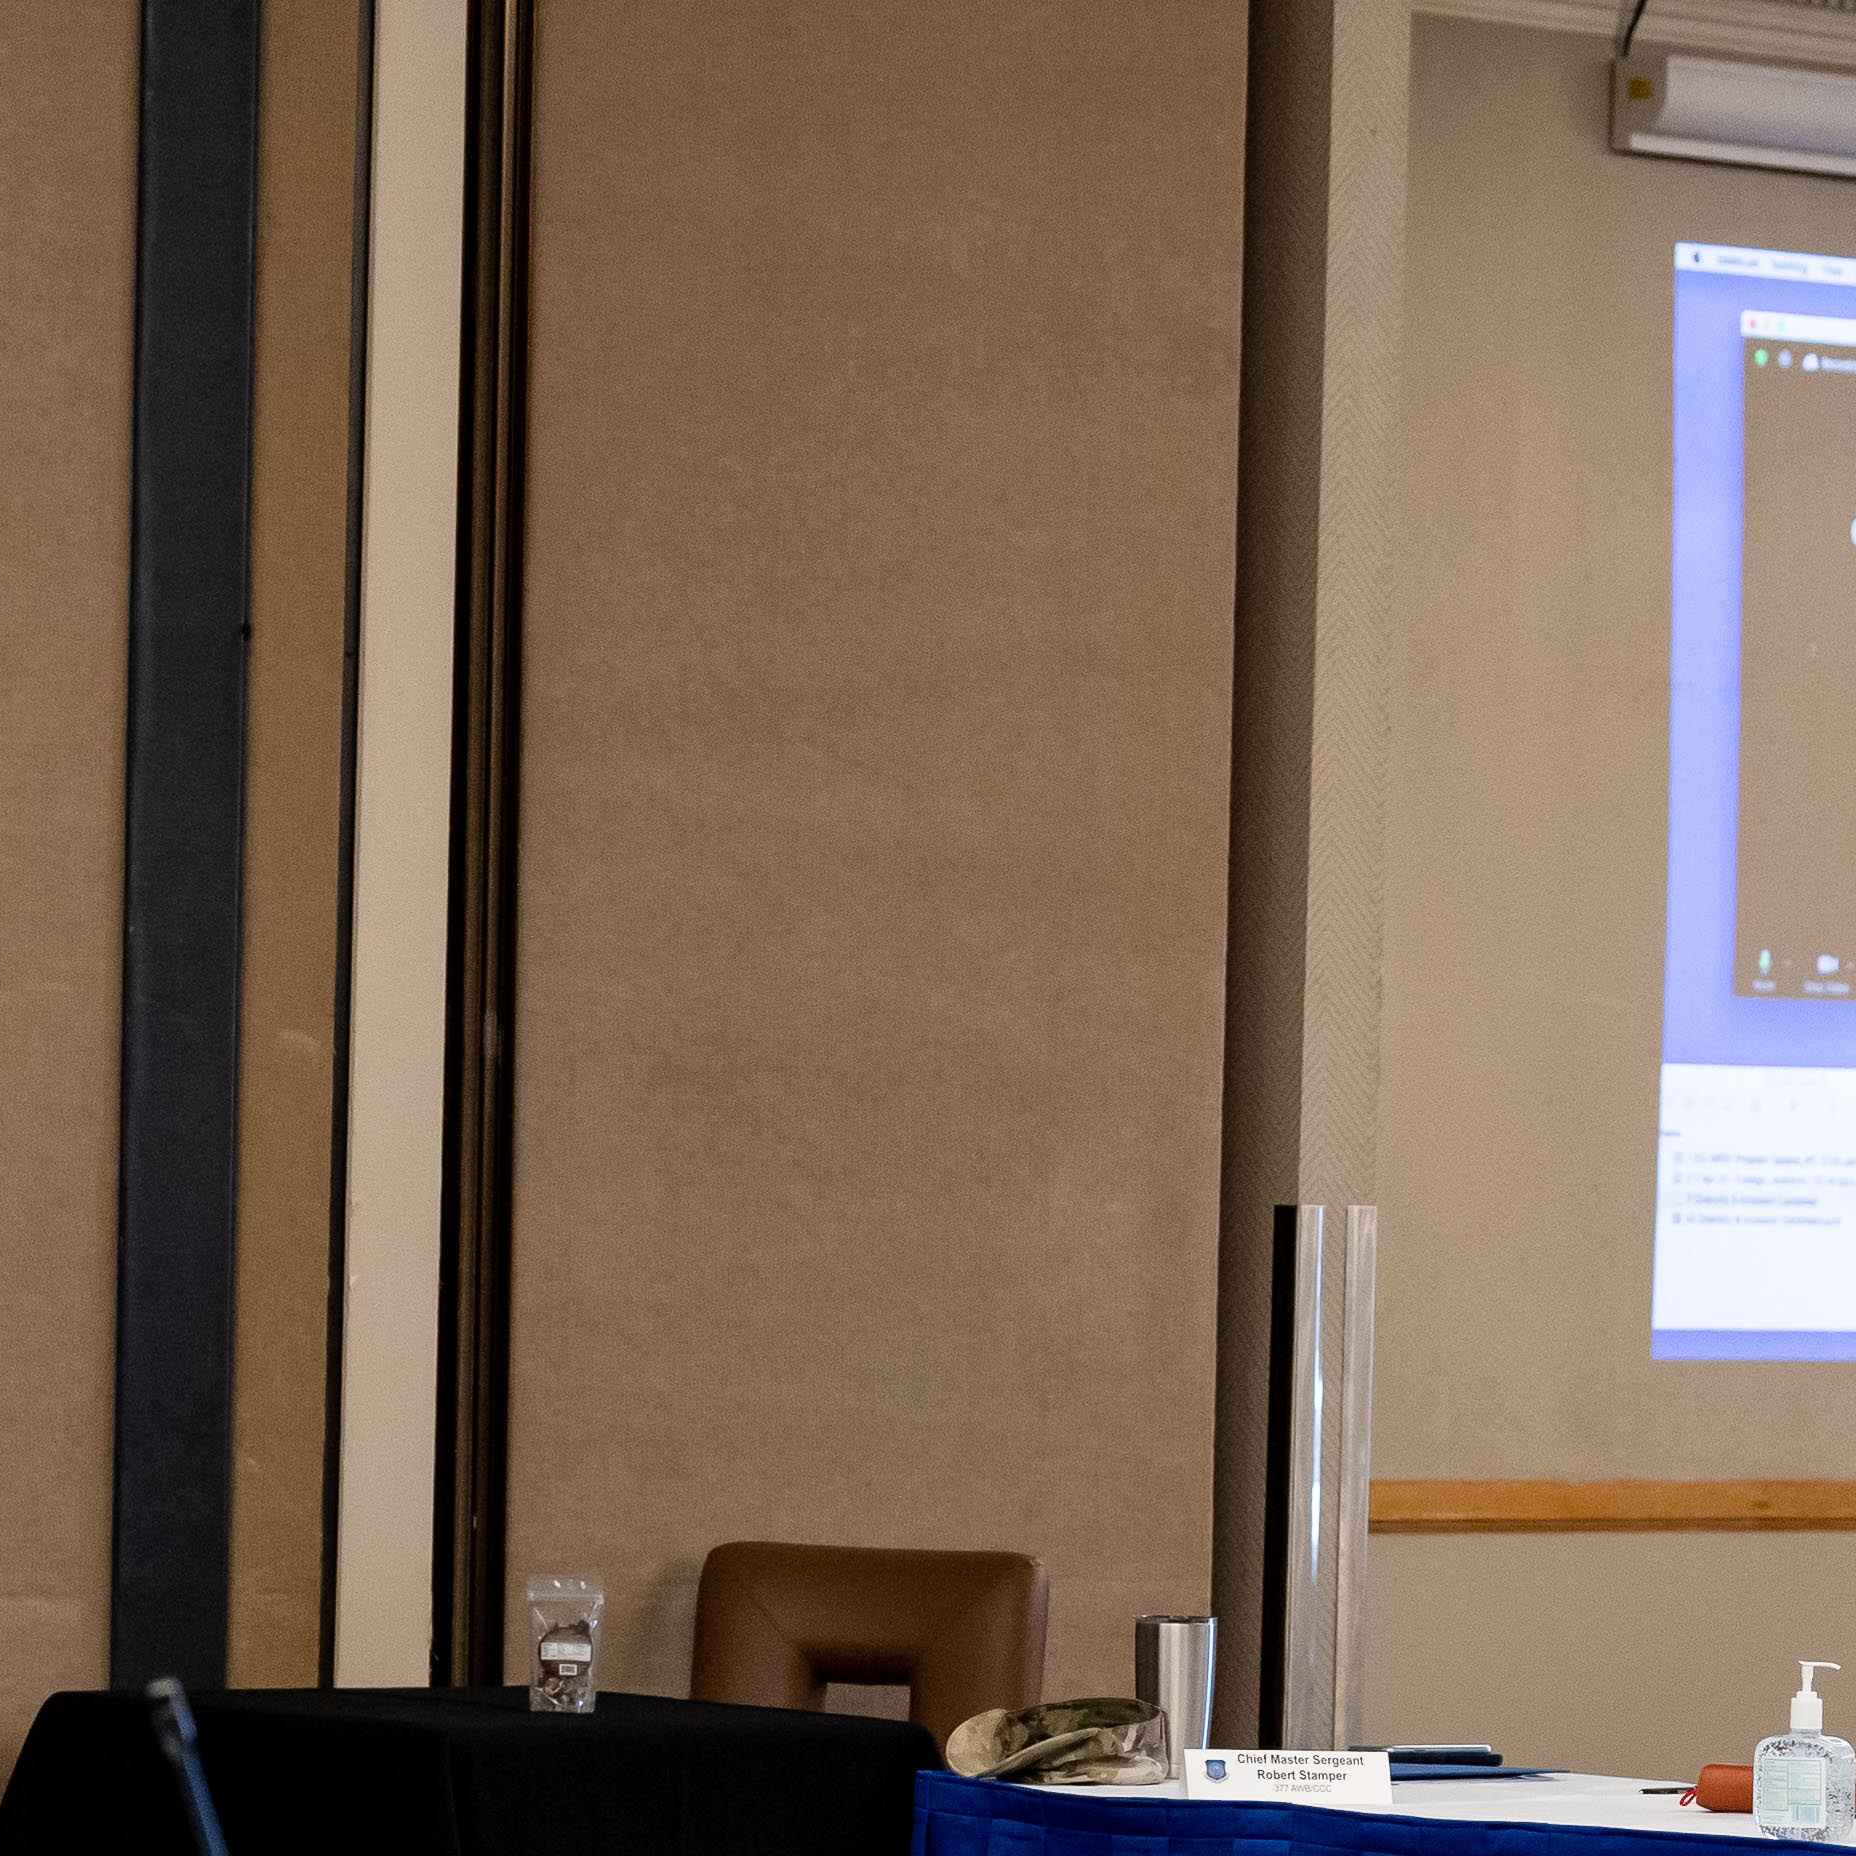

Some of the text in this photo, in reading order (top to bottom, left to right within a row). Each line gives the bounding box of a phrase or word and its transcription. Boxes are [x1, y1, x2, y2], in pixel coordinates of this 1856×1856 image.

[1237, 1754, 1364, 1768] Chief Master Sergeant
[1257, 1770, 1347, 1782] Robert Stamper
[1274, 1784, 1289, 1793] 377
